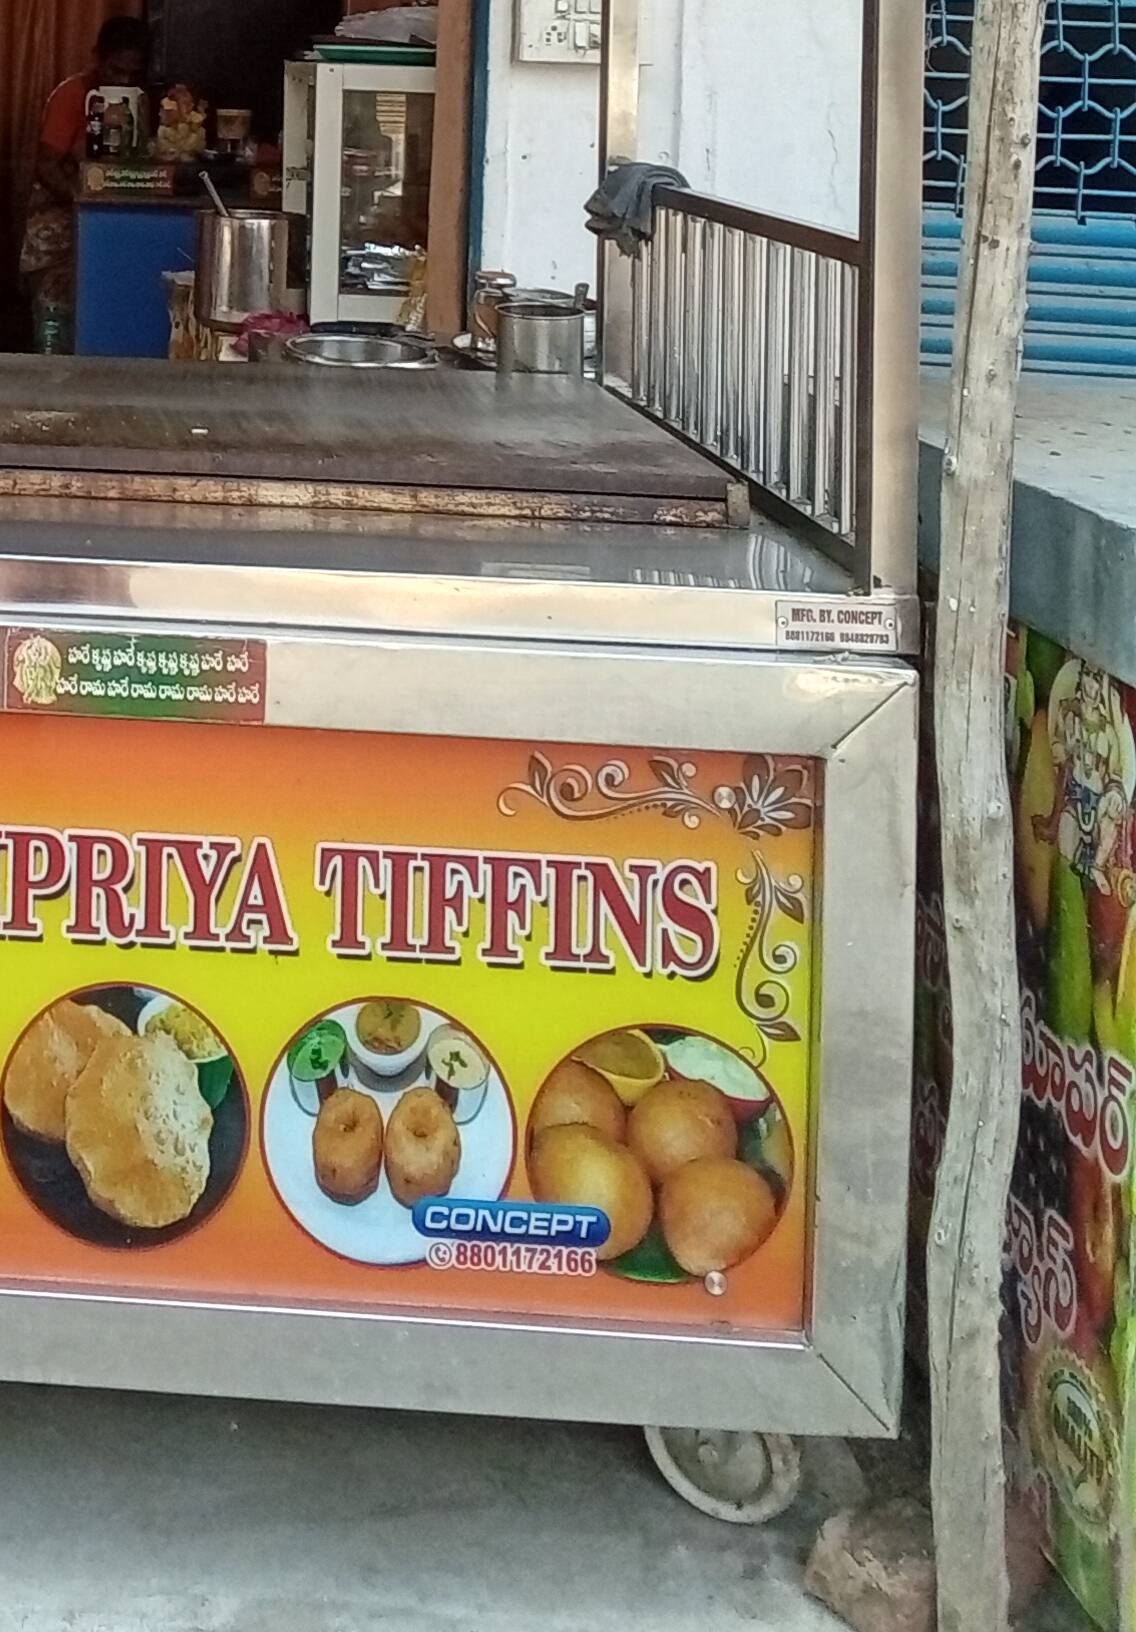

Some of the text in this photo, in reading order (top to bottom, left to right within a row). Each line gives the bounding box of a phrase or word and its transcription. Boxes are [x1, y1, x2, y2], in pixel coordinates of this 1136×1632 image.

[837, 610, 883, 625] CONCEPT
[320, 845, 715, 972] TIFFINS
[424, 1205, 598, 1239] CONCEPT
[454, 1244, 594, 1274] 8801172166
